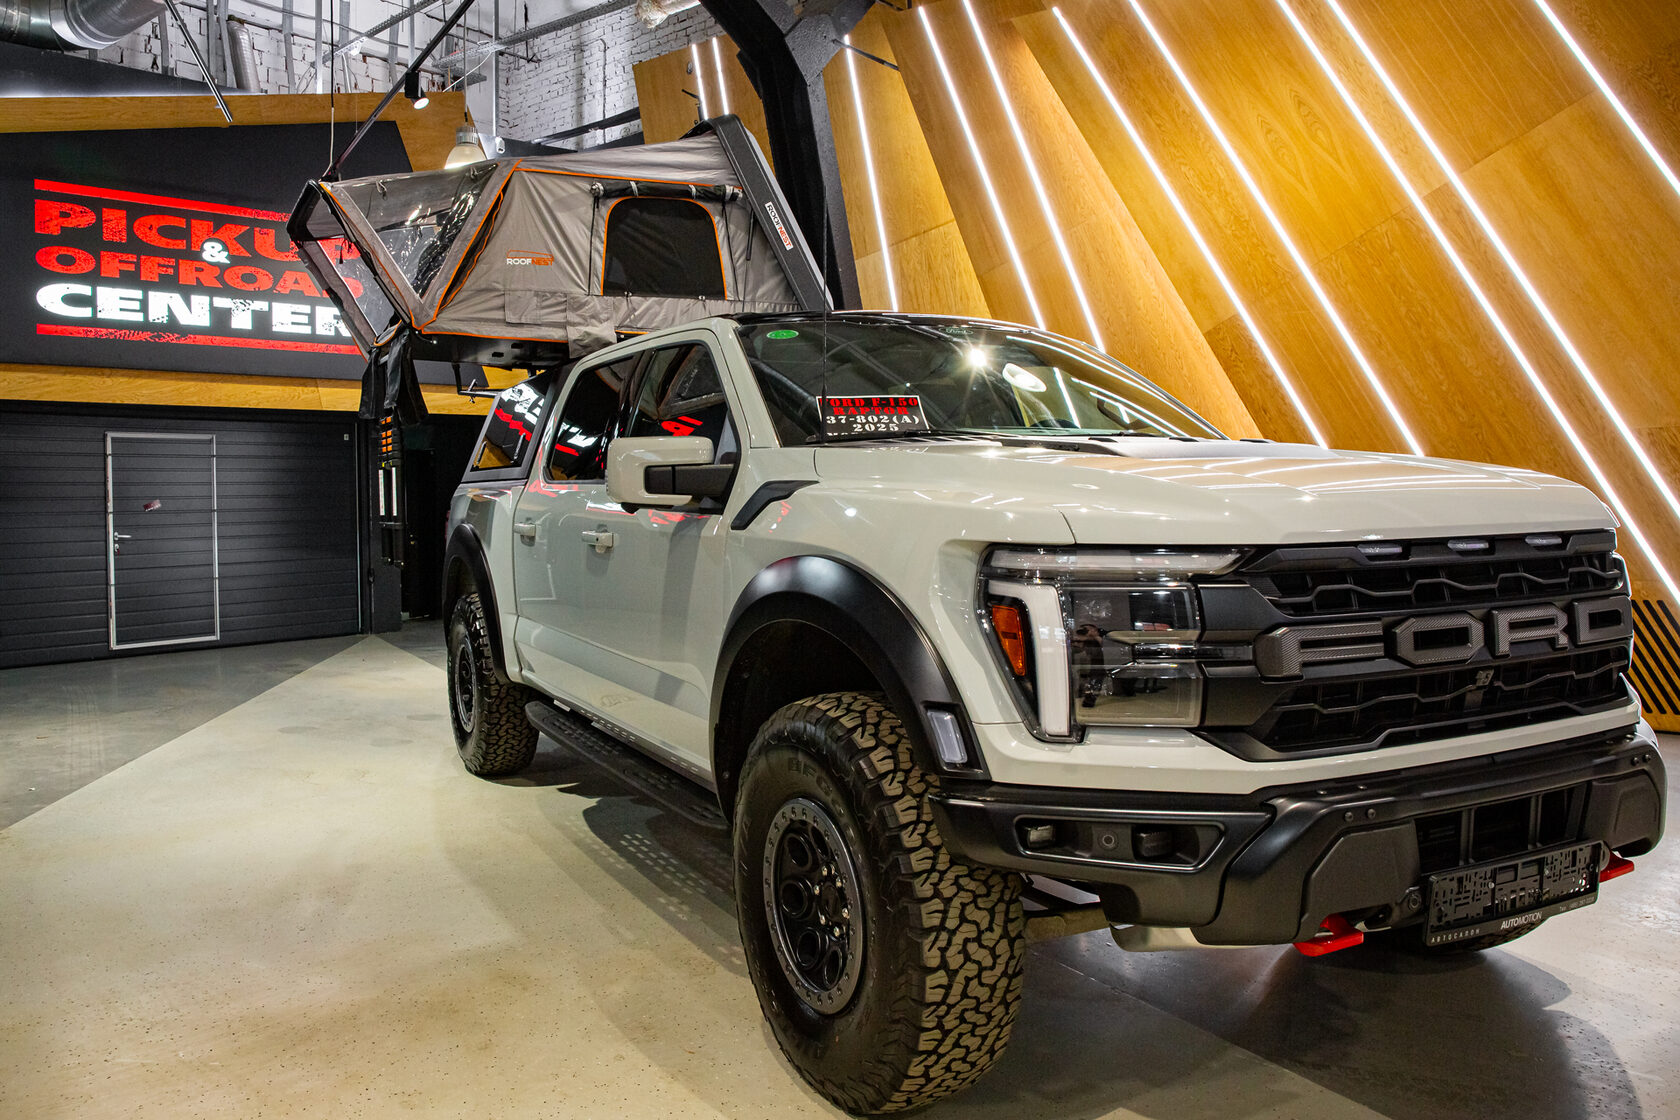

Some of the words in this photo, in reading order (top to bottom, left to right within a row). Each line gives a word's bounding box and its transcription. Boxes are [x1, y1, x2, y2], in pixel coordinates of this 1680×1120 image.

[202, 242, 230, 264] &
[36, 283, 352, 337] CENTER
[871, 397, 918, 407] F-150
[833, 406, 910, 415] RAPTOR
[826, 415, 919, 424] 37-802(A)
[852, 424, 899, 432] 2025
[1256, 600, 1633, 677] FORD
[1500, 912, 1543, 930] AUTOMOTION
